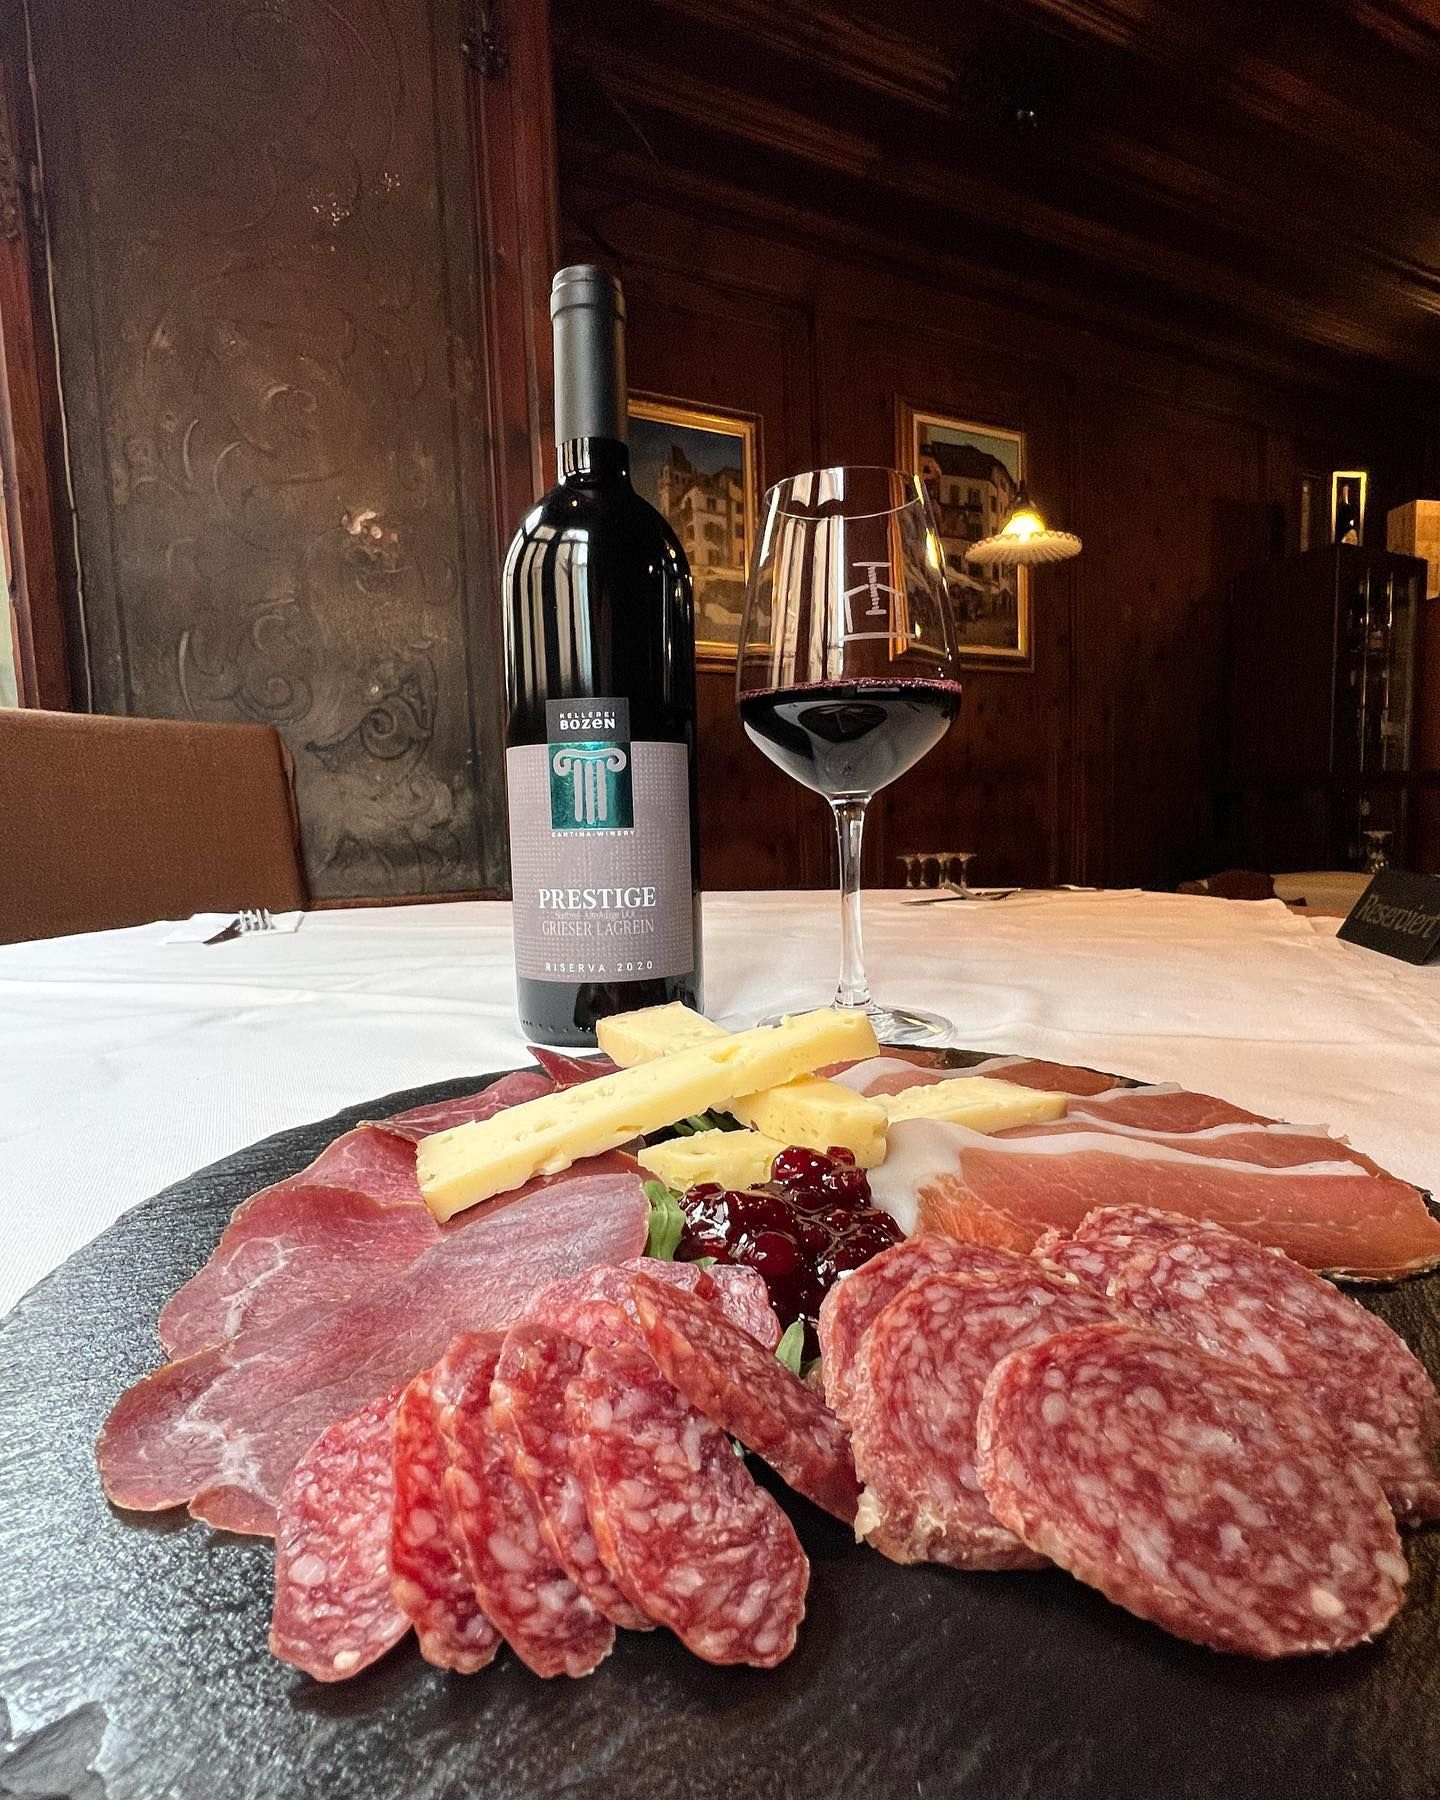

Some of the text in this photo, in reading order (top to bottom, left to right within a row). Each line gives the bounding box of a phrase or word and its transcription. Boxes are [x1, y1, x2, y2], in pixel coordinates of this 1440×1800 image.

[539, 887, 656, 909] PRESTIGE
[543, 918, 655, 937] GRIESER LAGREIN
[545, 960, 653, 973] RISERVA 2020
